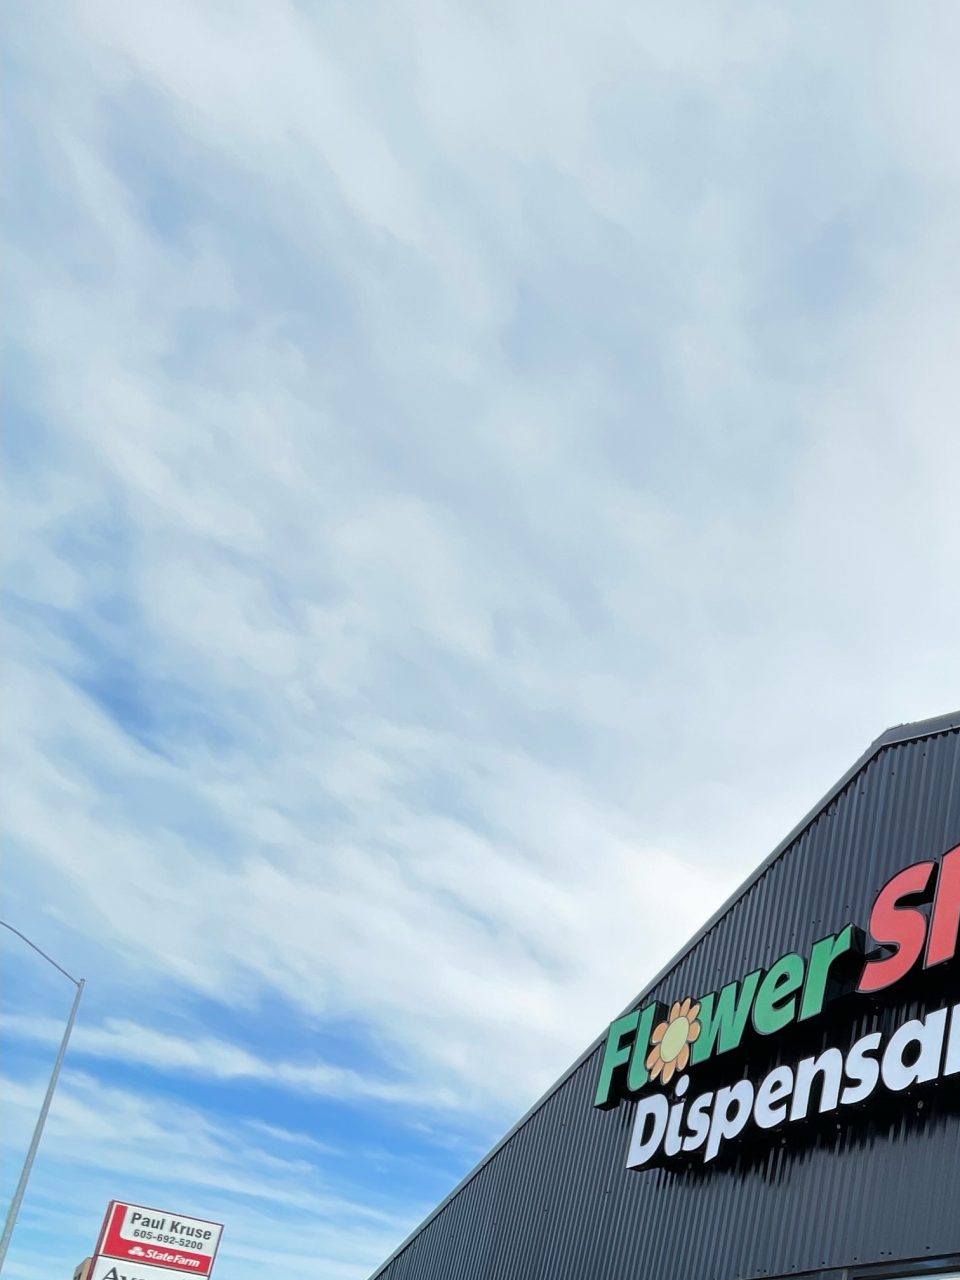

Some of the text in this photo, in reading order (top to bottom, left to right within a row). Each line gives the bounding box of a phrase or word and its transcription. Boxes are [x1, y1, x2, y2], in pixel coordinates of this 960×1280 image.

[593, 923, 857, 1111] Flower
[130, 1212, 212, 1241] Paul Kruse
[133, 1229, 203, 1251] 605-692-5200
